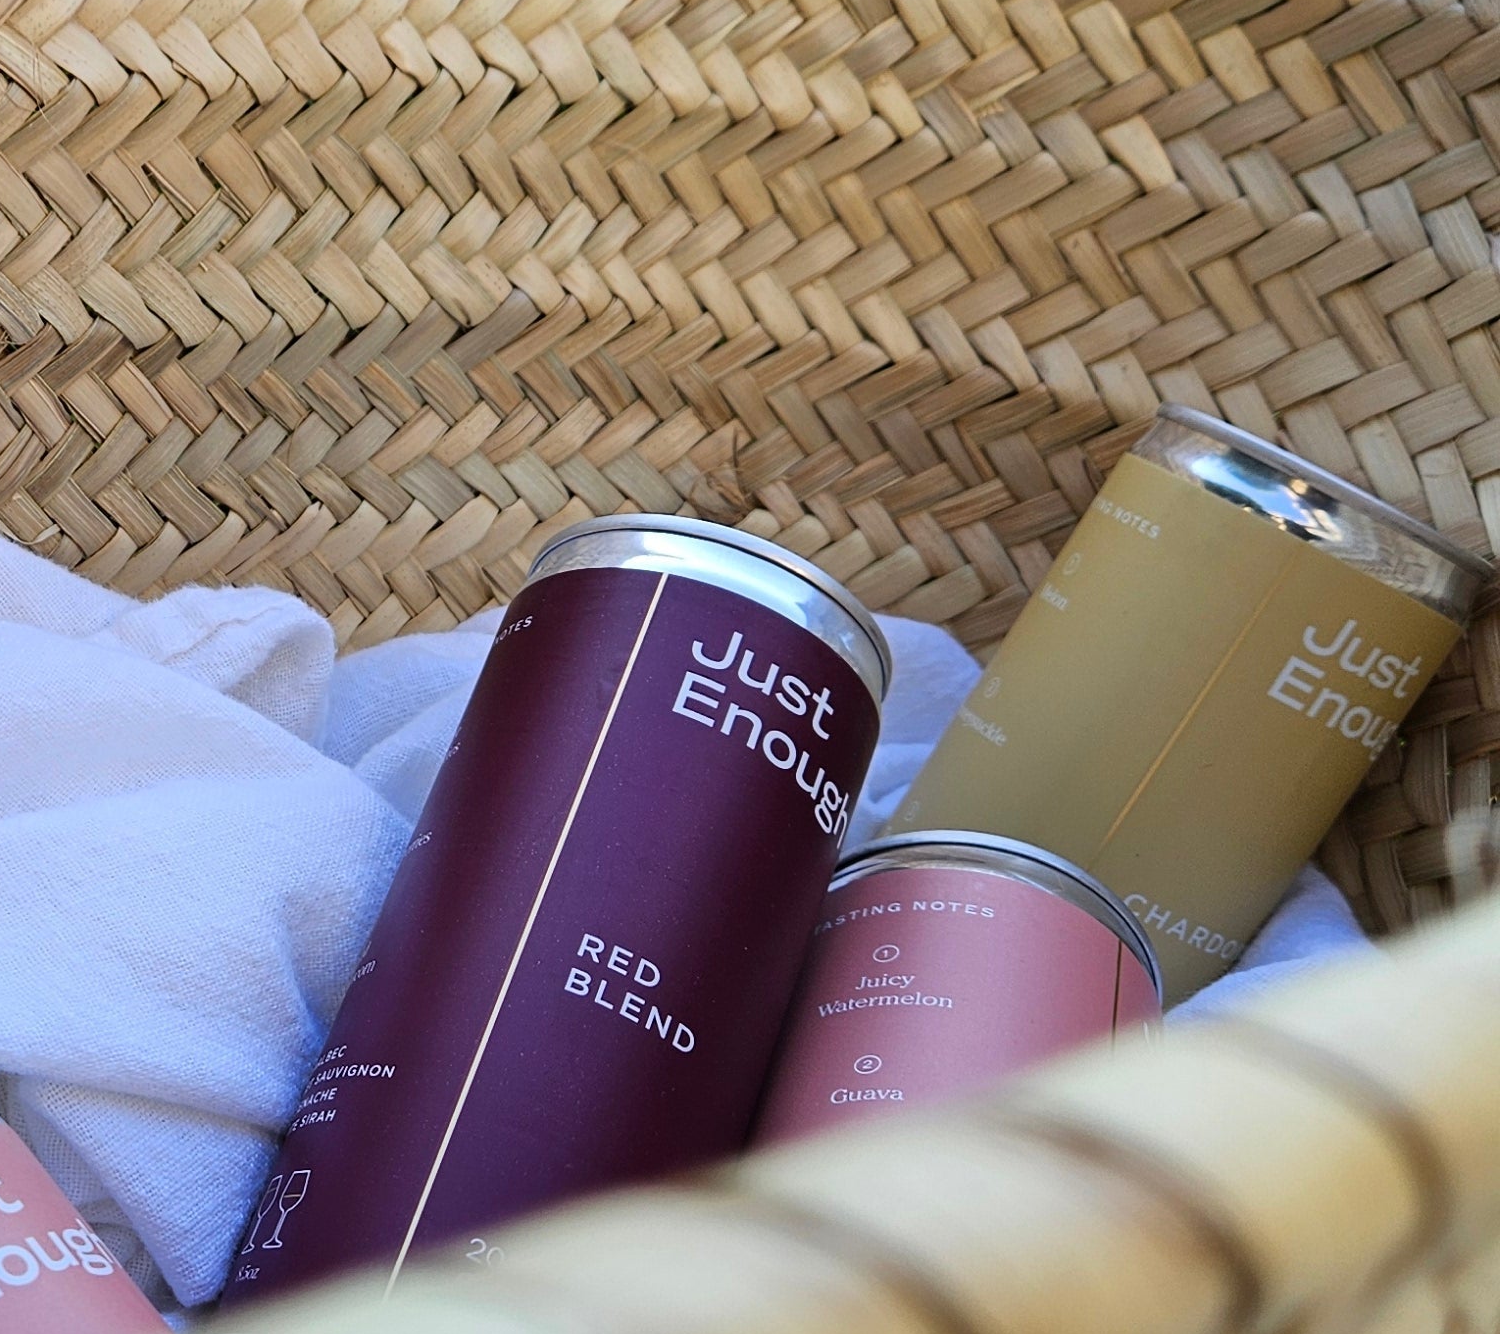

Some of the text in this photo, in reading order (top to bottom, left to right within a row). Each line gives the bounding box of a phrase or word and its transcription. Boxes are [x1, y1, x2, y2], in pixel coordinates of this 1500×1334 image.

[1303, 619, 1422, 698] Just
[692, 631, 834, 739] Just
[672, 671, 849, 849] Enough
[814, 900, 995, 936] TASTING NOTES
[1123, 893, 1243, 959] CHARDO
[577, 933, 661, 987] RED
[855, 973, 915, 990] Juicy
[565, 967, 695, 1053] BLEND
[818, 992, 953, 1017] Watermelon
[314, 1064, 396, 1086] SAUVIGNON
[830, 1088, 904, 1104] Guava
[300, 1109, 336, 1128] SIRAH
